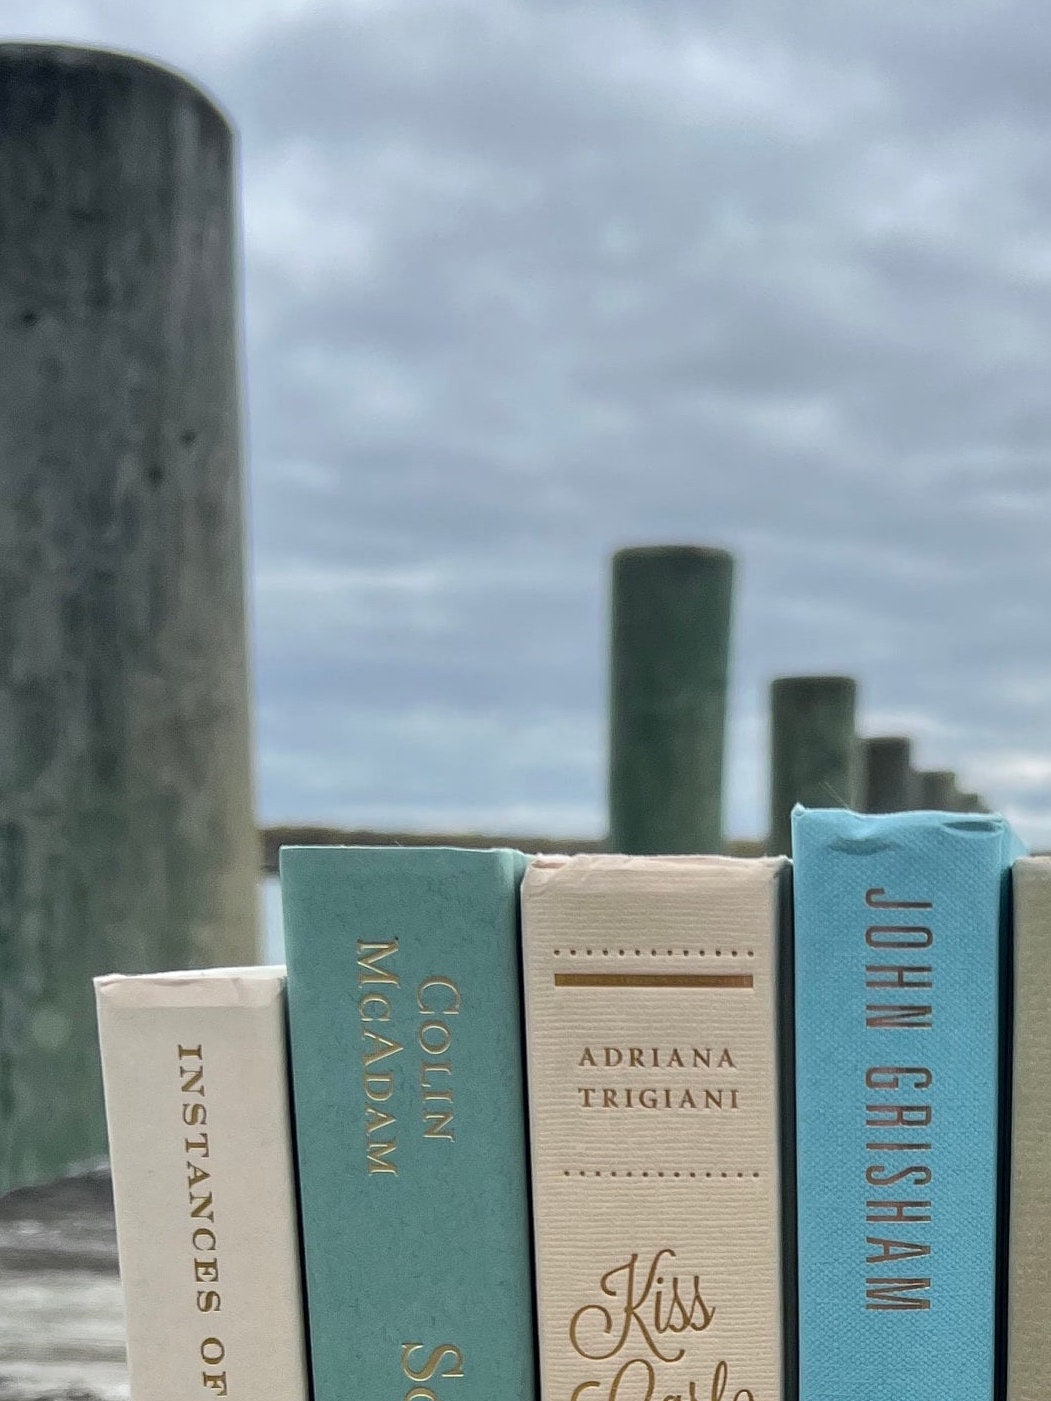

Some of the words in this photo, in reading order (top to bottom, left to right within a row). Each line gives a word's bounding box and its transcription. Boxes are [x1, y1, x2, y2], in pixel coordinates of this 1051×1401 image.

[865, 887, 933, 1030] JOHN
[416, 975, 461, 1143] COLIN
[577, 1047, 737, 1069] ADRIANA
[577, 1088, 741, 1110] TRIGIANI
[177, 1044, 222, 1314] INSTANCES
[865, 1066, 933, 1312] GRISHAM
[199, 1336, 229, 1397] OF
[569, 1249, 716, 1363] Kiss
